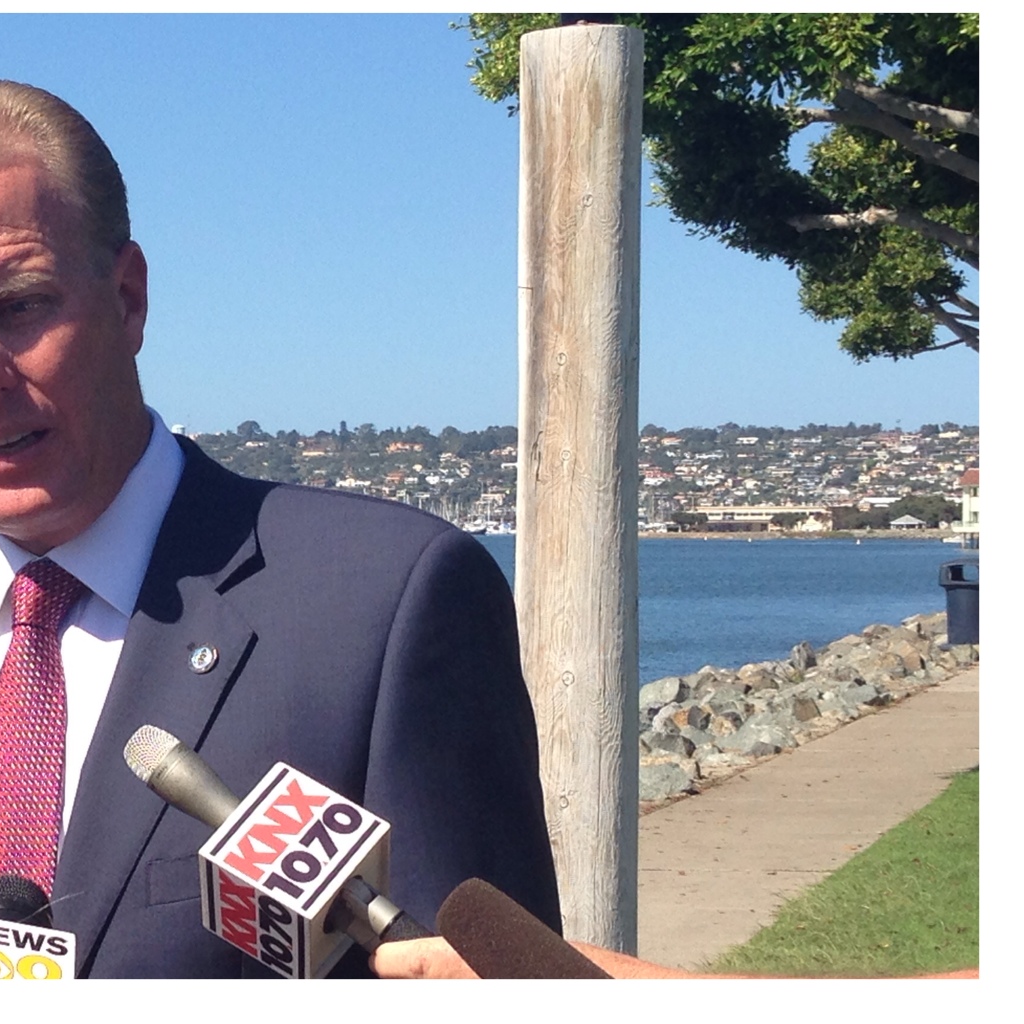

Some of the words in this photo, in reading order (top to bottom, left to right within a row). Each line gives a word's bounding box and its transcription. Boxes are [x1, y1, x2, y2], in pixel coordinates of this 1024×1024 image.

[223, 778, 330, 881] KNX
[262, 803, 363, 899] 1070
[218, 870, 258, 958] KNX
[258, 895, 294, 976] 1070
